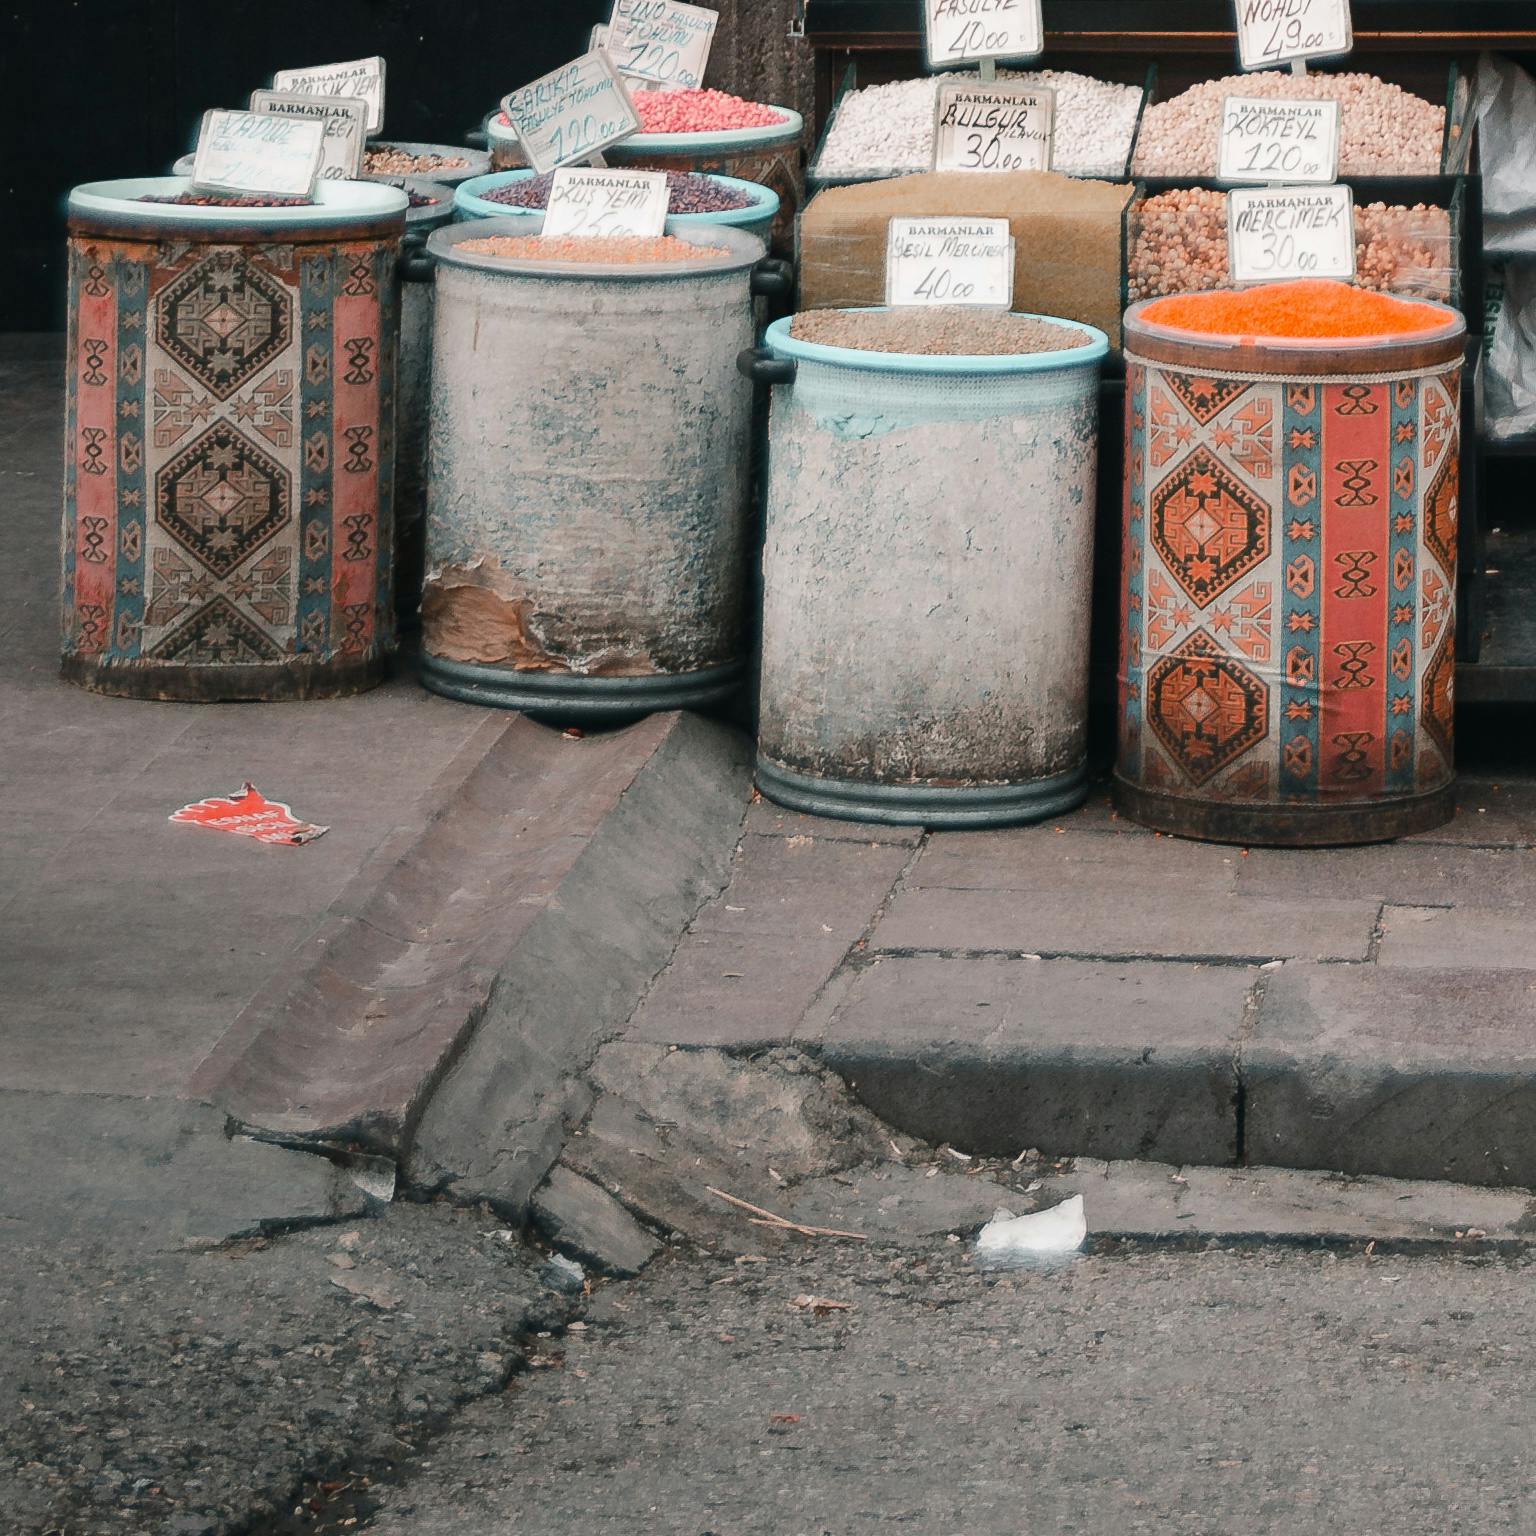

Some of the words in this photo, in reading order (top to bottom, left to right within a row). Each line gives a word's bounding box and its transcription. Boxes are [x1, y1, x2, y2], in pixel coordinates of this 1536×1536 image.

[955, 94, 1037, 106] BARMANLAR
[268, 102, 352, 119] BARMANLAR
[1240, 105, 1323, 117] BARMANLAR
[568, 176, 650, 190] BARMANLAR
[1247, 196, 1334, 209] BARMANLAR
[908, 226, 994, 236] BARMANLAR
